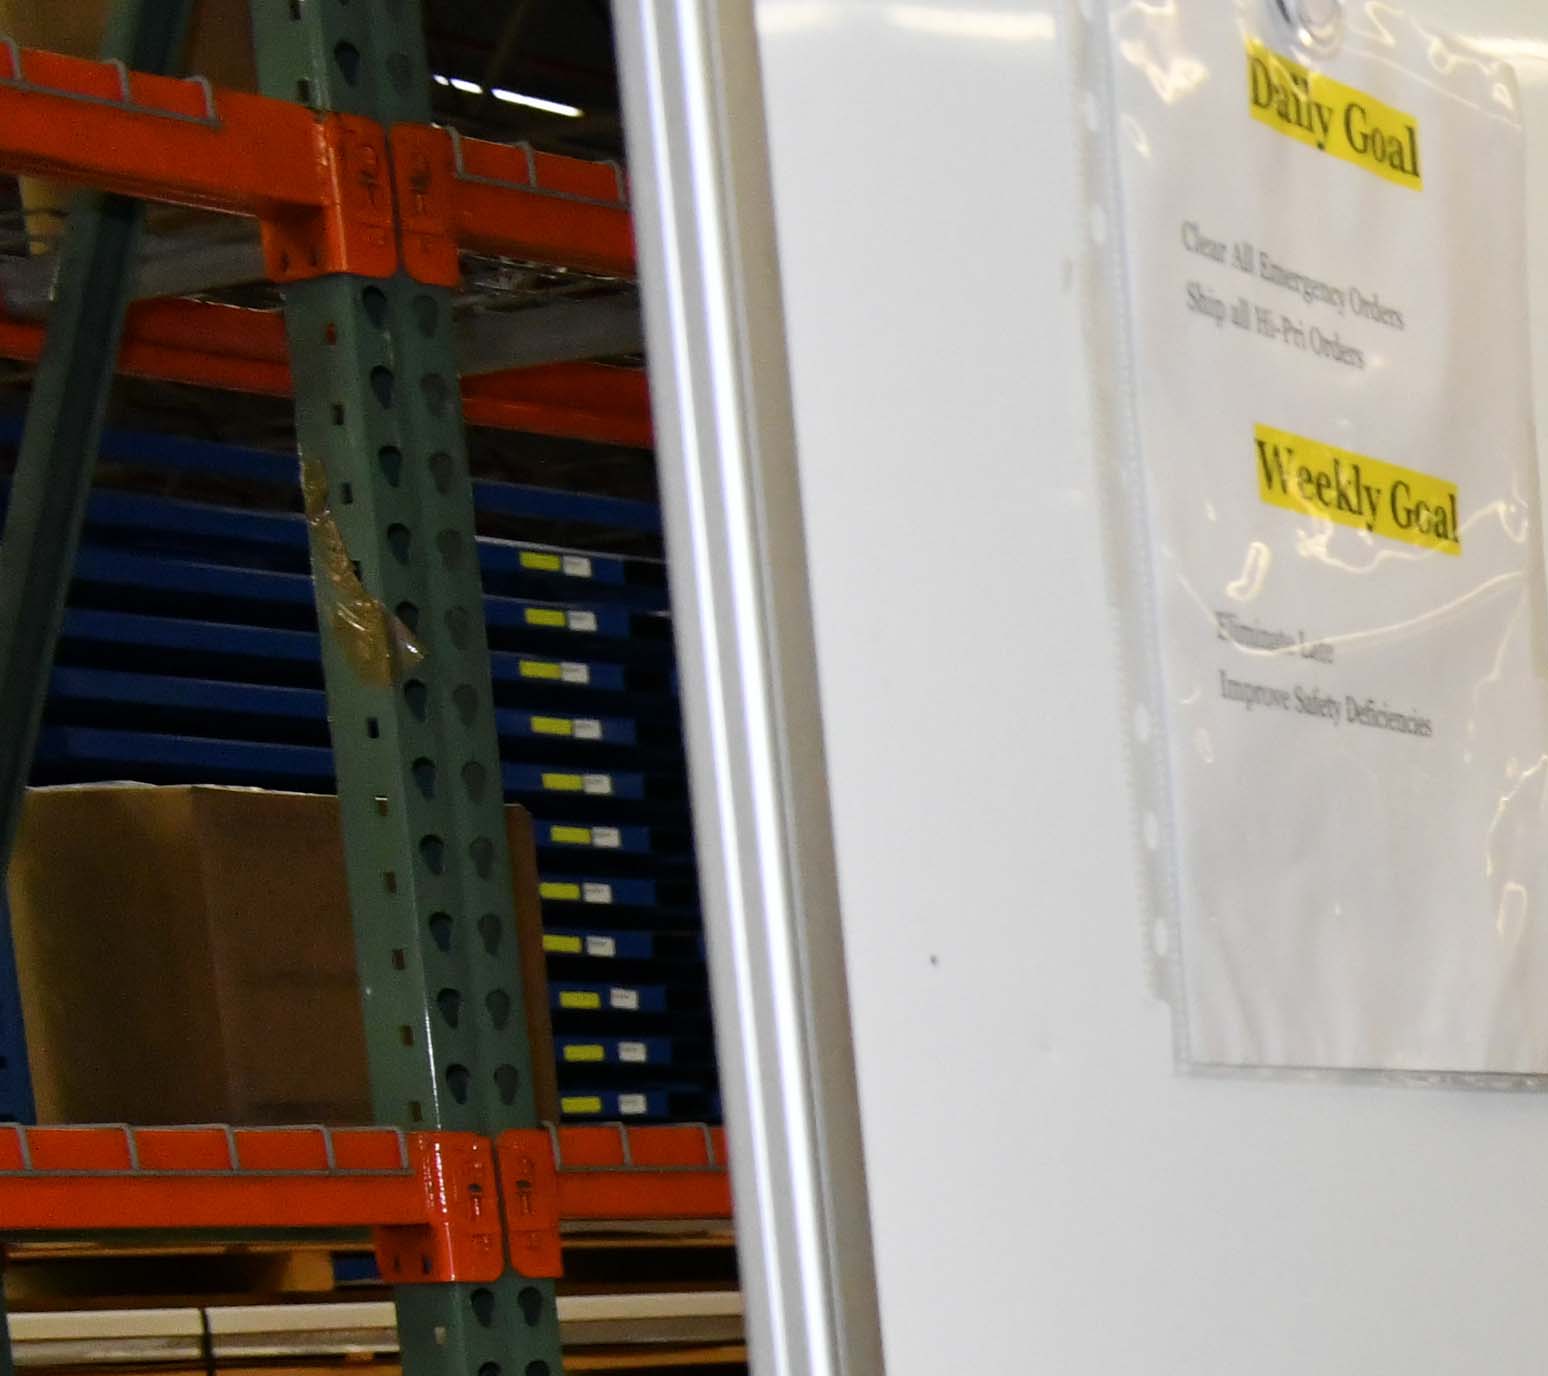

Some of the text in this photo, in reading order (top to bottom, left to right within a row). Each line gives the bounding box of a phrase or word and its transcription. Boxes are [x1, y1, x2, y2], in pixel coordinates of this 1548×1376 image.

[1249, 56, 1421, 179] Daily Goal
[1181, 221, 1404, 331] Clear All Emergency Orders
[1186, 281, 1224, 326] Ship
[1310, 325, 1365, 370] Orders
[1256, 438, 1461, 544] Weekly Goal
[1219, 669, 1433, 738] Improve Safety Deficiencies
